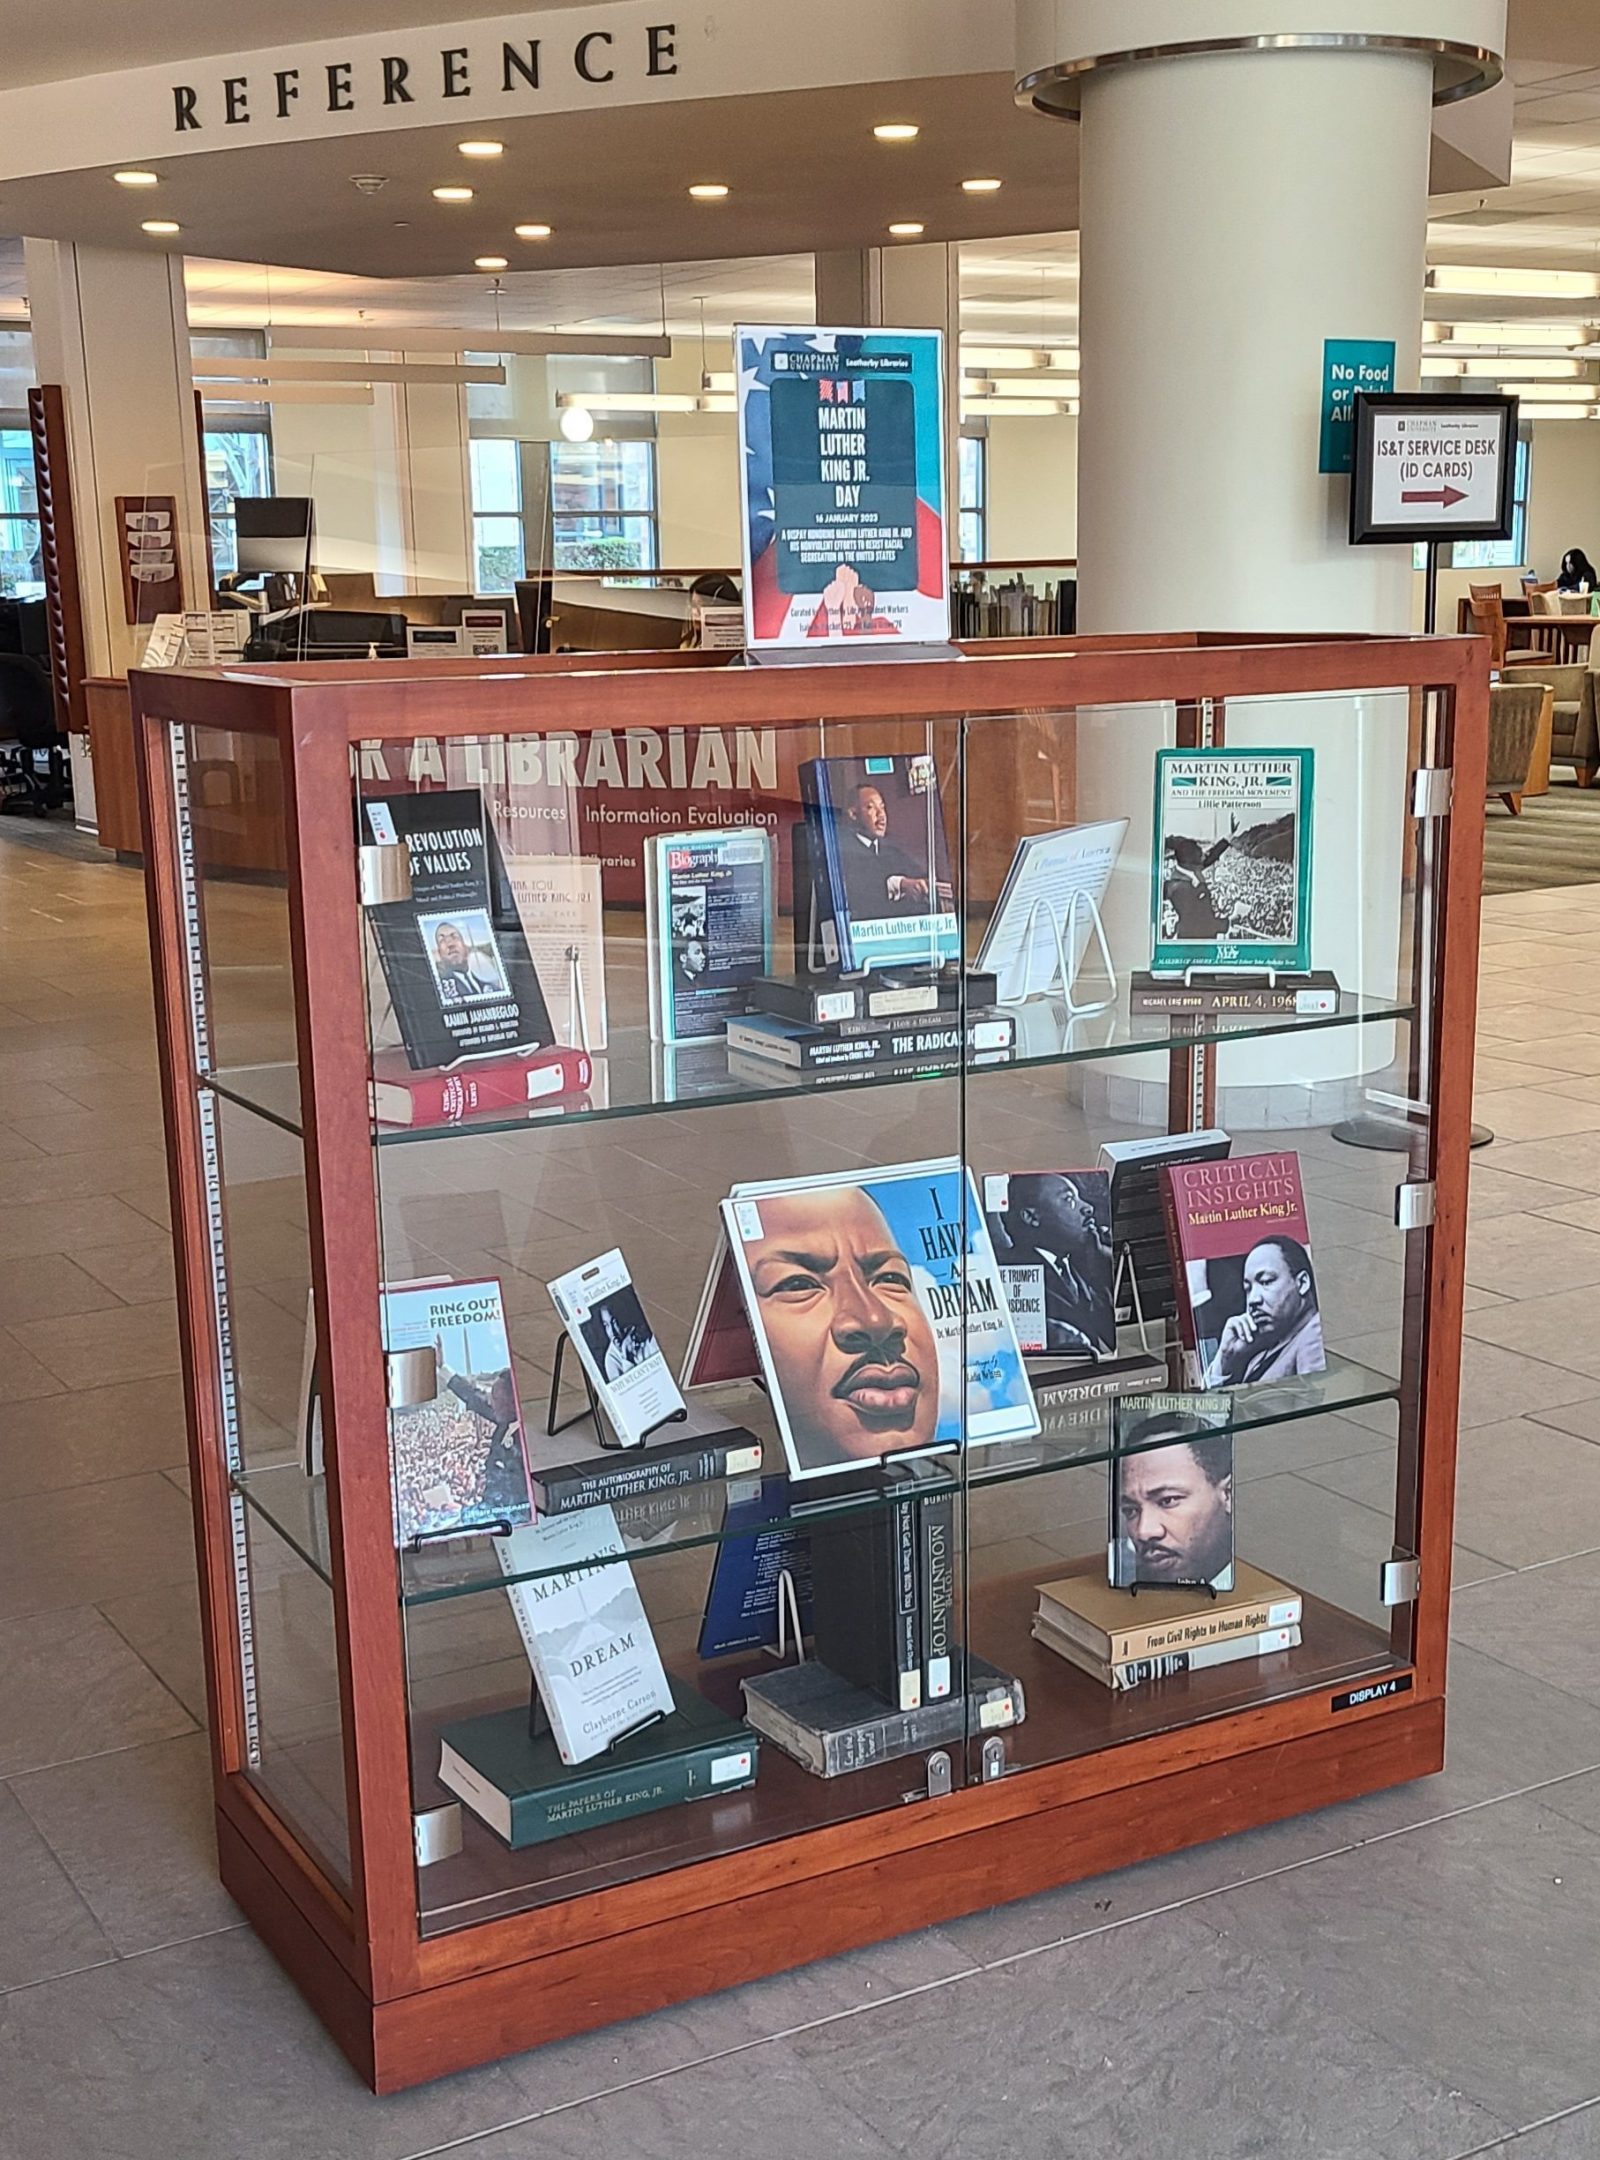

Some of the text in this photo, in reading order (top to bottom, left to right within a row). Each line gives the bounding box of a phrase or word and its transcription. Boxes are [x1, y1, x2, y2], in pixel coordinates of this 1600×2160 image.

[172, 24, 678, 131] REFERENCE
[789, 353, 840, 363] CHAPMAN
[789, 362, 840, 371] UNIVERSITY
[845, 358, 909, 371] Leatherby Libraries
[1331, 364, 1389, 381] No Food
[1332, 388, 1349, 401] or
[818, 407, 866, 430] MARTIN
[820, 433, 866, 456] LUTHER
[1377, 439, 1496, 457] IS&T SERVICE DESK
[820, 459, 870, 482] KING JR.
[1400, 461, 1473, 482] (ID CARDS)
[835, 485, 861, 508] DAY
[824, 513, 859, 524] JANUARY
[860, 513, 878, 523] 2023
[408, 726, 779, 790] A LIBRARIAN
[1170, 762, 1292, 775] MARTIN LUTHER
[1198, 775, 1263, 789] KING, JR.
[493, 800, 779, 827] Resources Information Evaluation
[1221, 800, 1262, 809] Patterson
[405, 828, 483, 854] REVOLUTION
[423, 852, 472, 875] VALUES
[852, 922, 884, 938] Martin
[885, 920, 916, 936] Luther
[944, 918, 955, 930] Jr.
[1212, 995, 1251, 1008] APRIL
[809, 1044, 832, 1057] MARTIN
[833, 1042, 854, 1053] LUTHER
[892, 1035, 914, 1054] THE
[1183, 1159, 1294, 1188] CRITICAL
[928, 1187, 944, 1221] I
[1187, 1177, 1295, 1208] INSIGHTS
[1188, 1209, 1223, 1226] Martin
[1224, 1206, 1257, 1222] Luther
[1259, 1203, 1285, 1219] King
[1284, 1201, 1298, 1217] Jr.
[918, 1222, 974, 1261] HAV
[1008, 1270, 1040, 1283] TRUMPET
[926, 1277, 999, 1320] DREAM
[1013, 1284, 1022, 1298] OF
[430, 1297, 498, 1316] RING OUT
[430, 1310, 501, 1328] FREEDOM!
[1043, 1384, 1102, 1407] DREAM
[1120, 1396, 1232, 1411] MARTIN LUTHER KING JR
[581, 1462, 671, 1492] THE AUTOBIOGRAPHY OF
[560, 1471, 693, 1510] MARTIN LUTHER KING, JR.
[931, 1524, 947, 1657] MOUNTAINTOP
[1147, 1613, 1267, 1649] From Civil Rights to Human Rights
[570, 1632, 636, 1678] DREAM
[1349, 1681, 1396, 1705] DISPLAY 4
[582, 1706, 626, 1736] Clayborne
[627, 1690, 657, 1710] Carson
[547, 1807, 584, 1822] MARTIN
[585, 1798, 622, 1815] LUTHER
[548, 1788, 616, 1814] THE PAPERS OF
